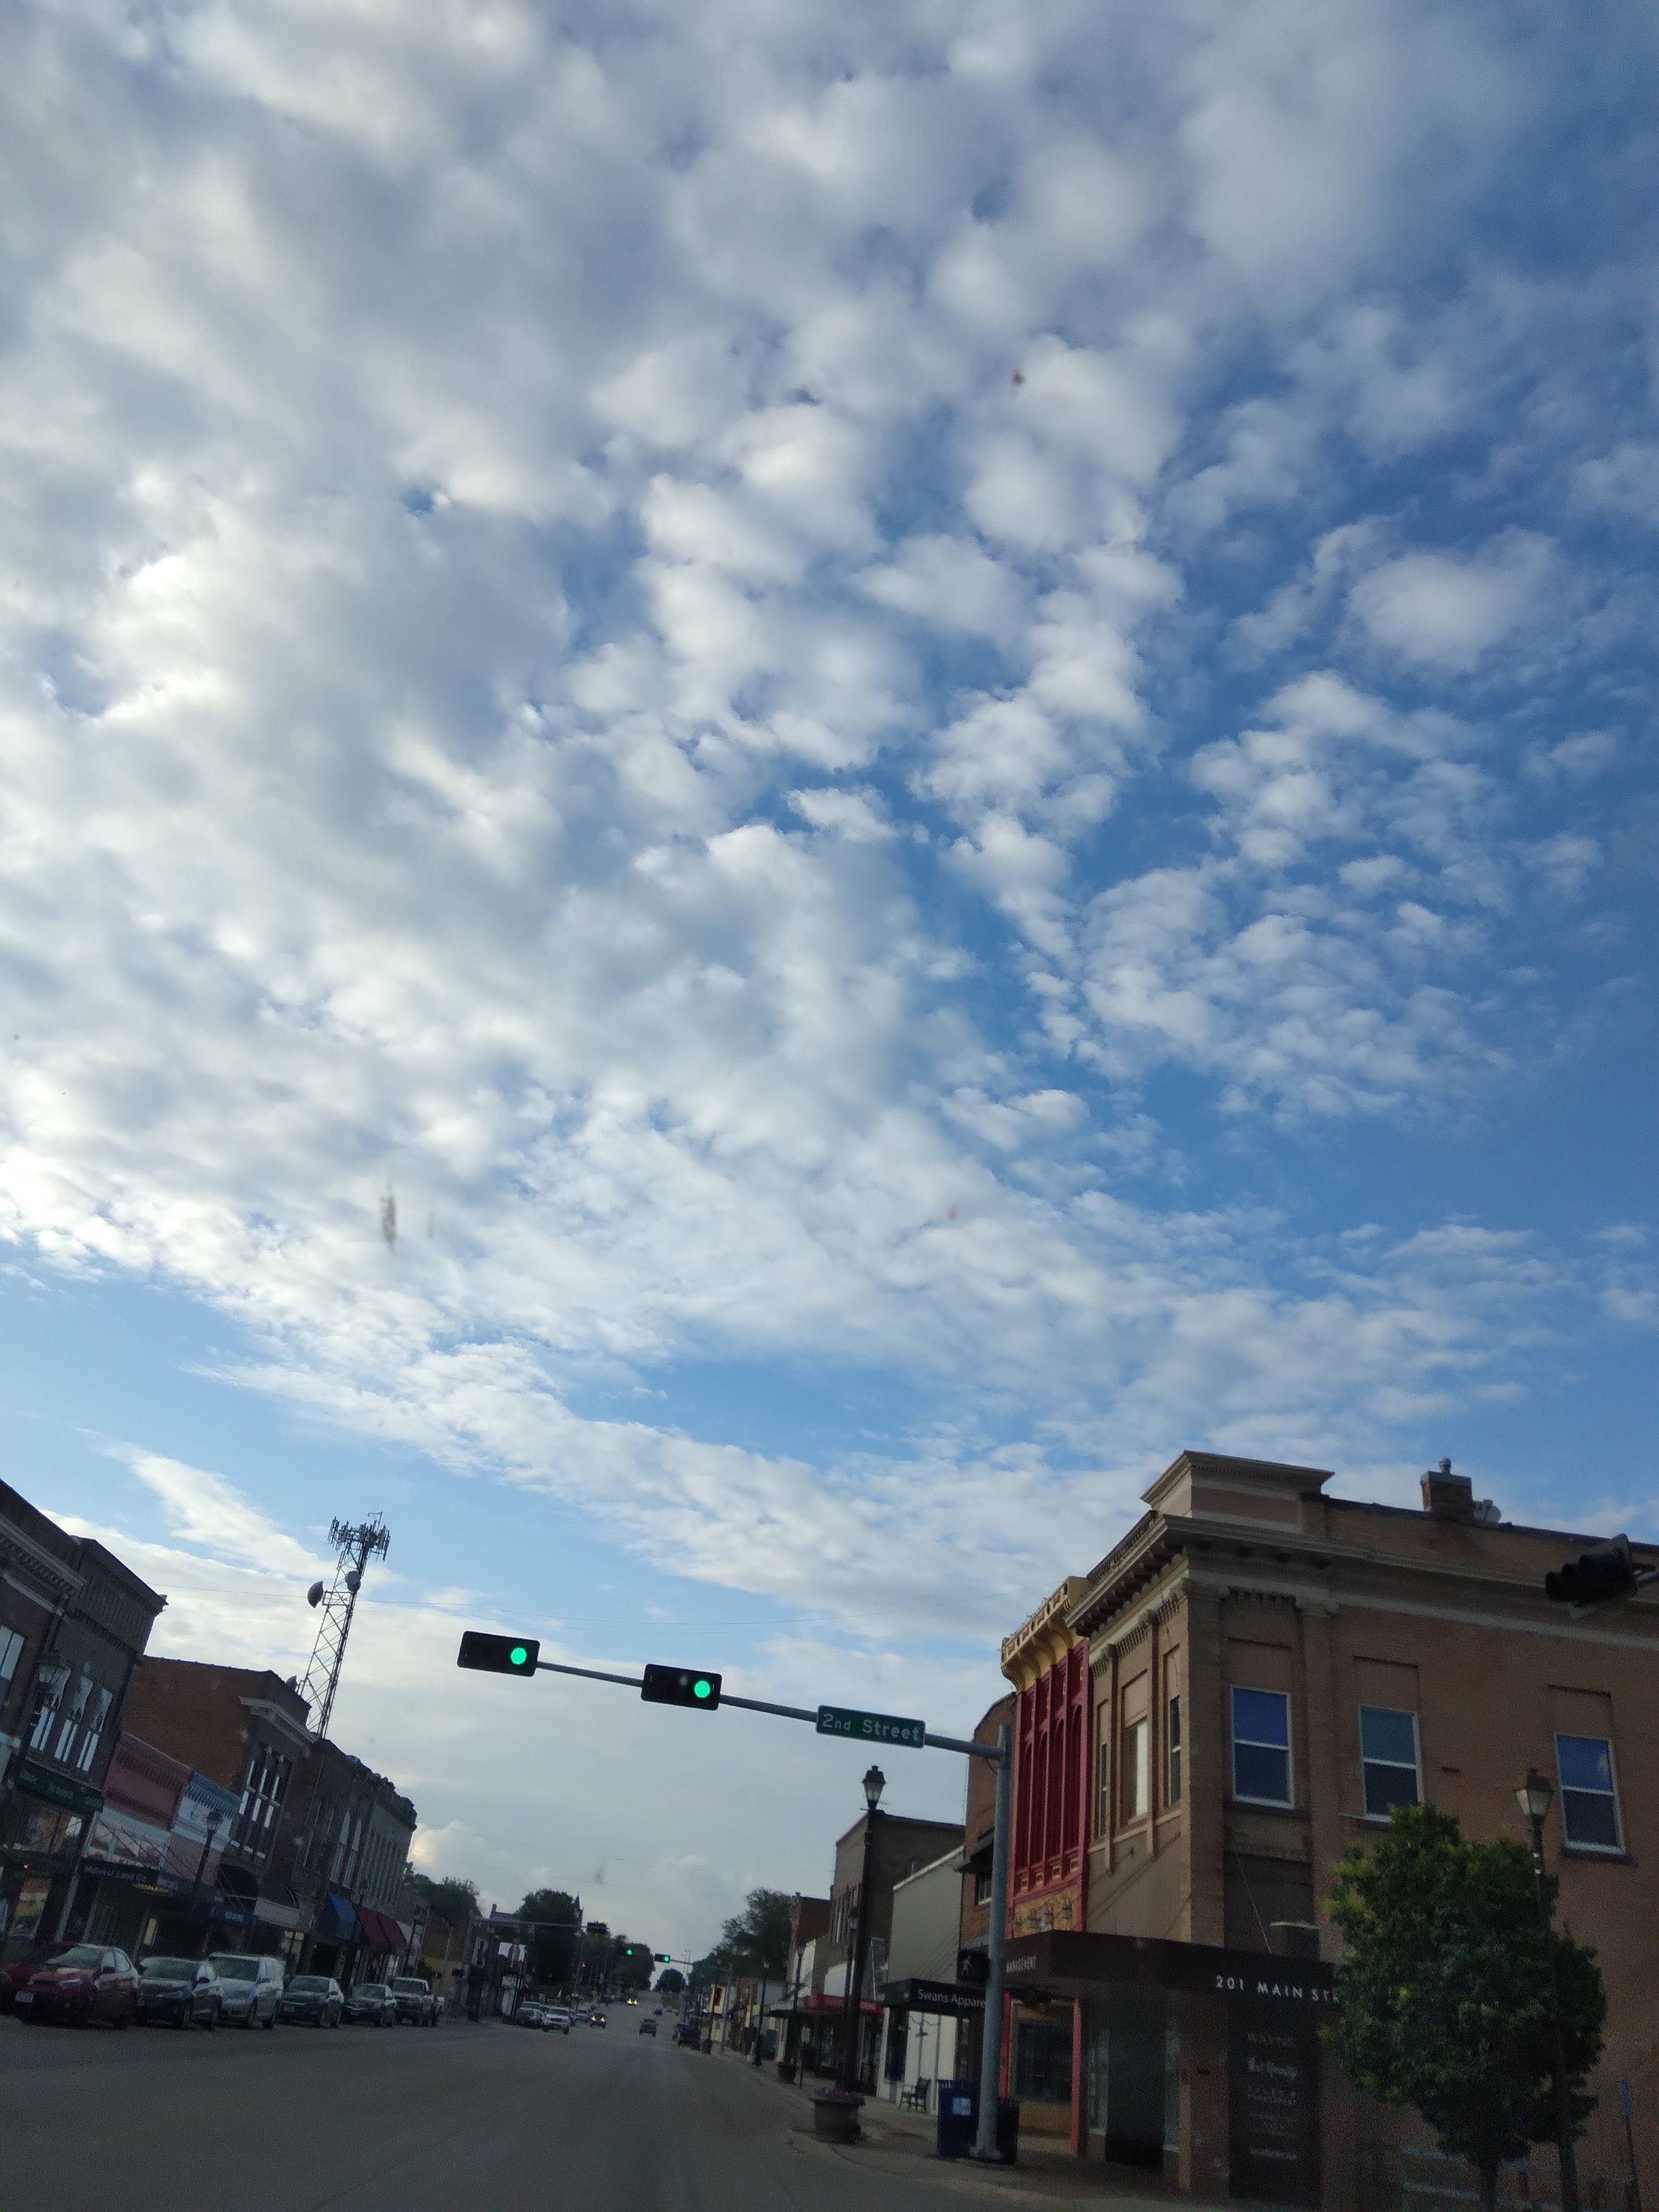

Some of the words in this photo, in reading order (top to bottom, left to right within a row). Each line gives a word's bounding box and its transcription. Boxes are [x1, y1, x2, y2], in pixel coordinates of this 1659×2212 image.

[822, 1713, 851, 1731] 2nd
[862, 1719, 919, 1741] Street
[917, 1988, 949, 2003] Swans
[950, 1993, 986, 2008] Appare
[1216, 1974, 1245, 1991] 201
[1256, 1981, 1303, 1999] MAIN
